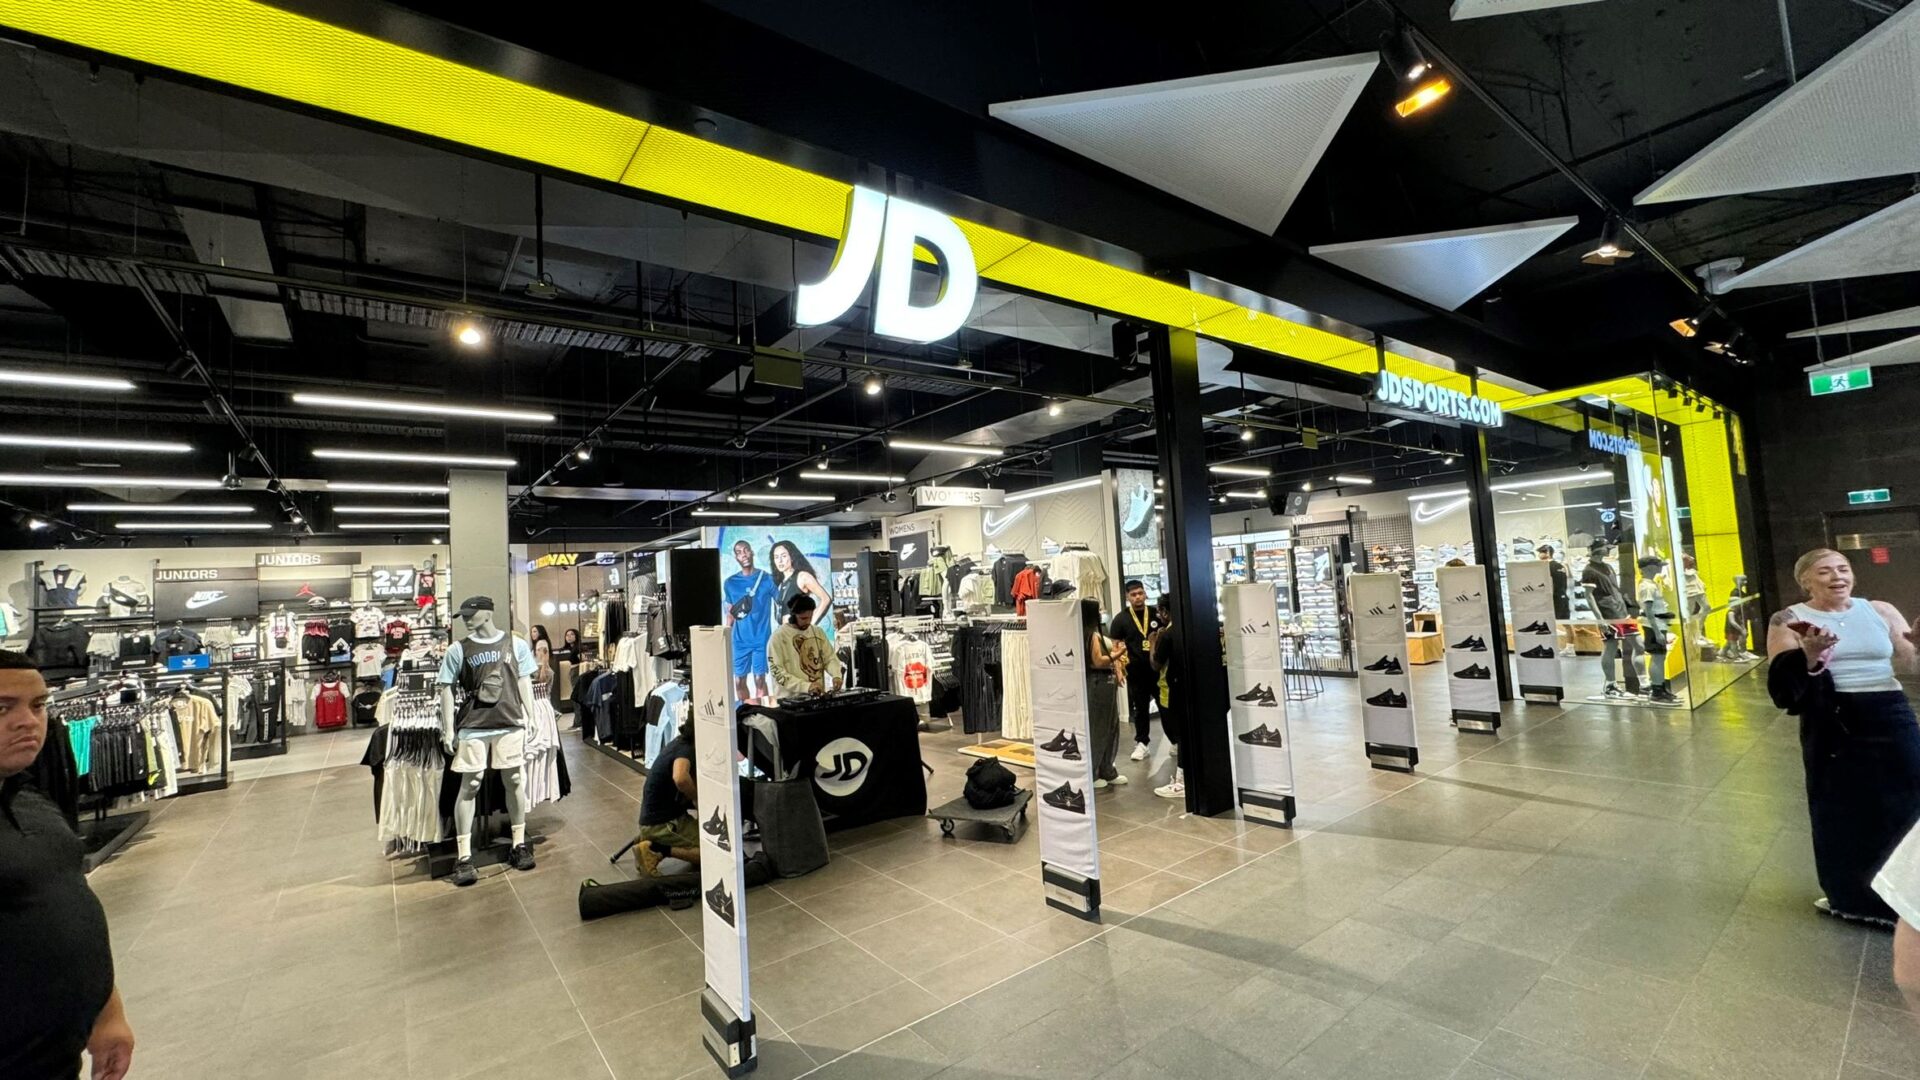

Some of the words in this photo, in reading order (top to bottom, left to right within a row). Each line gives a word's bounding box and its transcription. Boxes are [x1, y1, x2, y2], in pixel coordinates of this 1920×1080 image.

[797, 186, 978, 343] JD
[1377, 369, 1504, 428] JDSPORTS.COM
[888, 523, 915, 535] WOMENS
[257, 555, 321, 565] JUNIORS
[156, 570, 218, 580] JUNIORS
[373, 586, 413, 595] YEARS
[820, 753, 868, 781] JD
